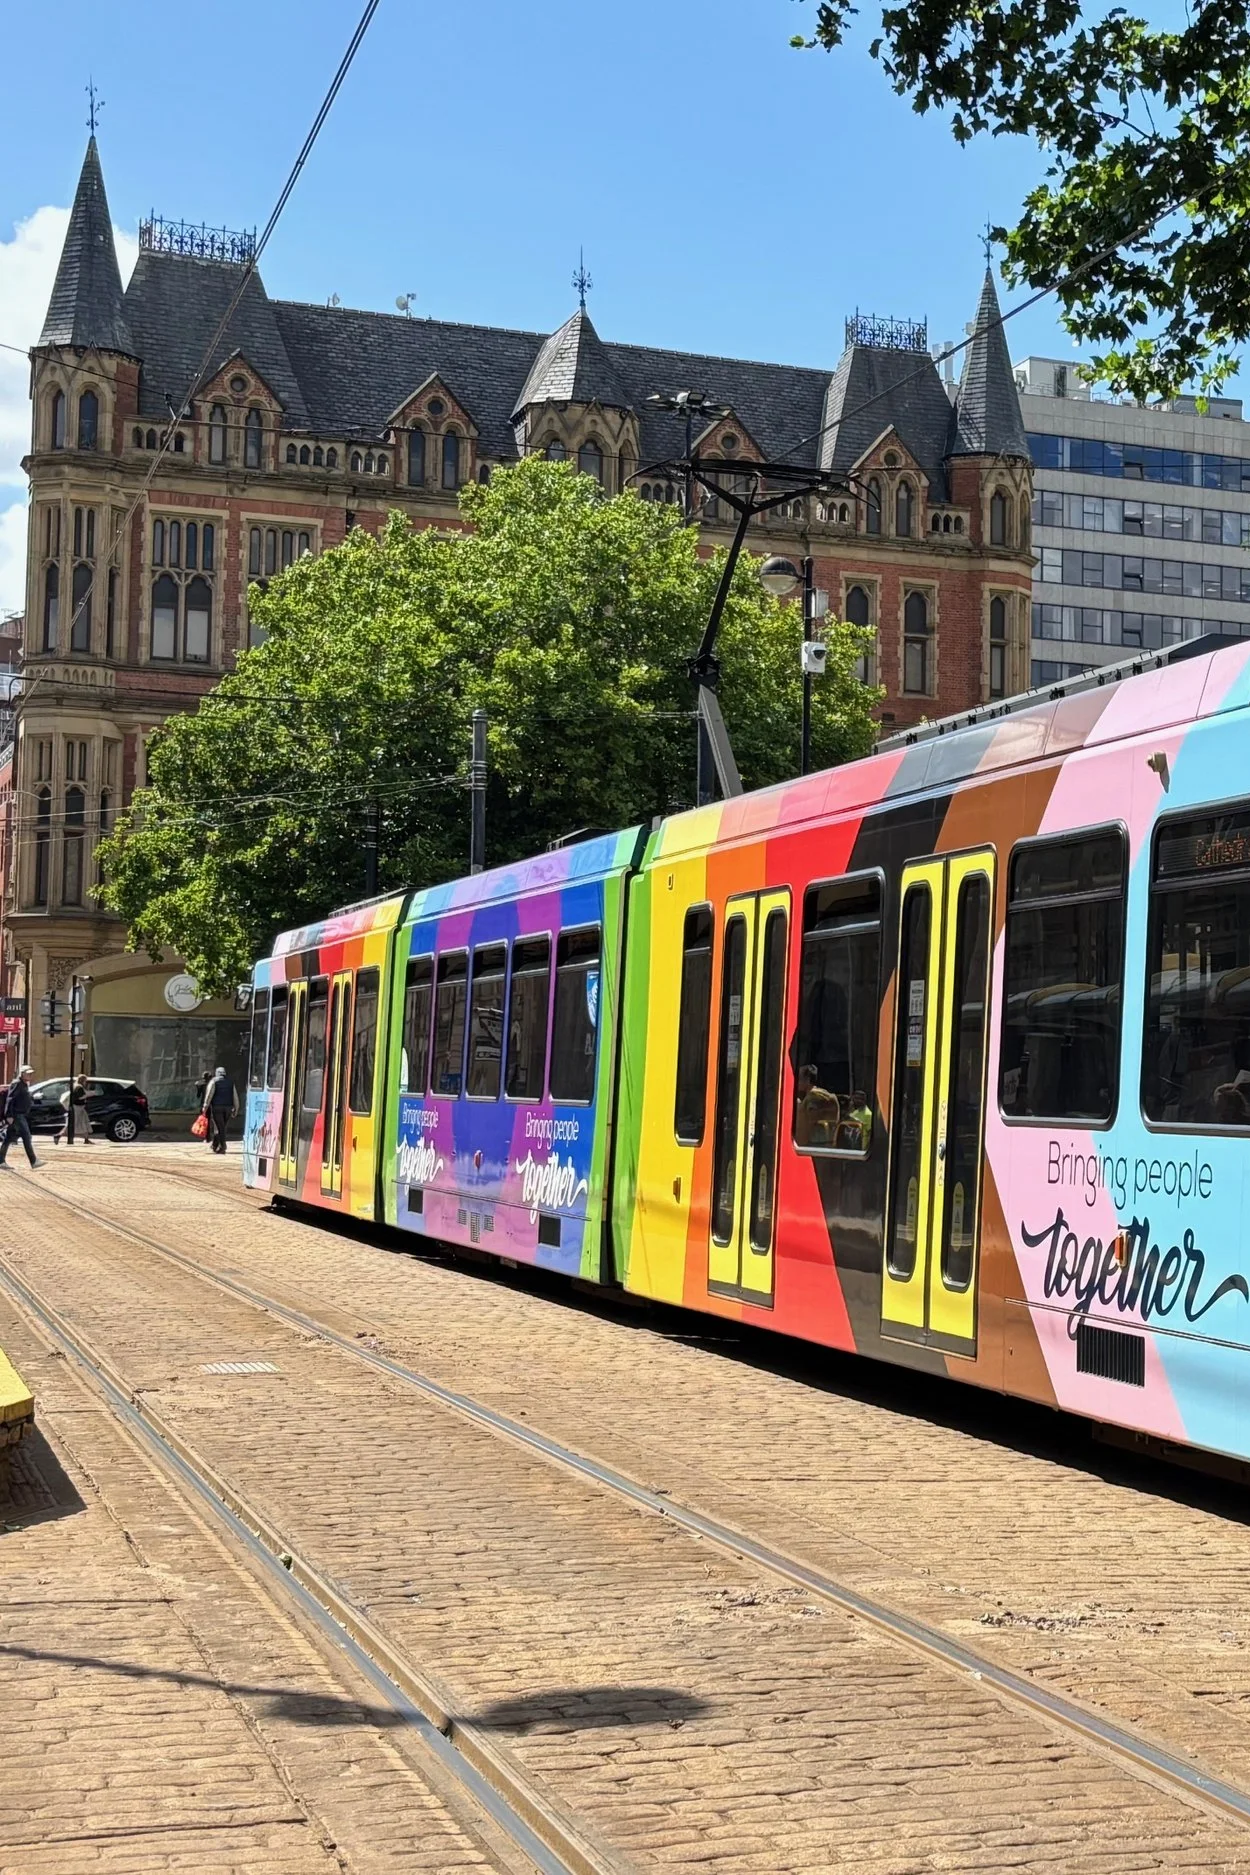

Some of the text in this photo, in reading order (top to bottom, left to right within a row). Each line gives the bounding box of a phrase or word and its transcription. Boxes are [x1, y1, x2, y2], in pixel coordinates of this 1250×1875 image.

[402, 1102, 422, 1135] Bringing
[525, 1111, 580, 1150] Bringing people
[396, 1132, 444, 1196] together
[516, 1148, 588, 1225] together
[1047, 1140, 1213, 1211] Bringing people
[1021, 1207, 1250, 1341] together
